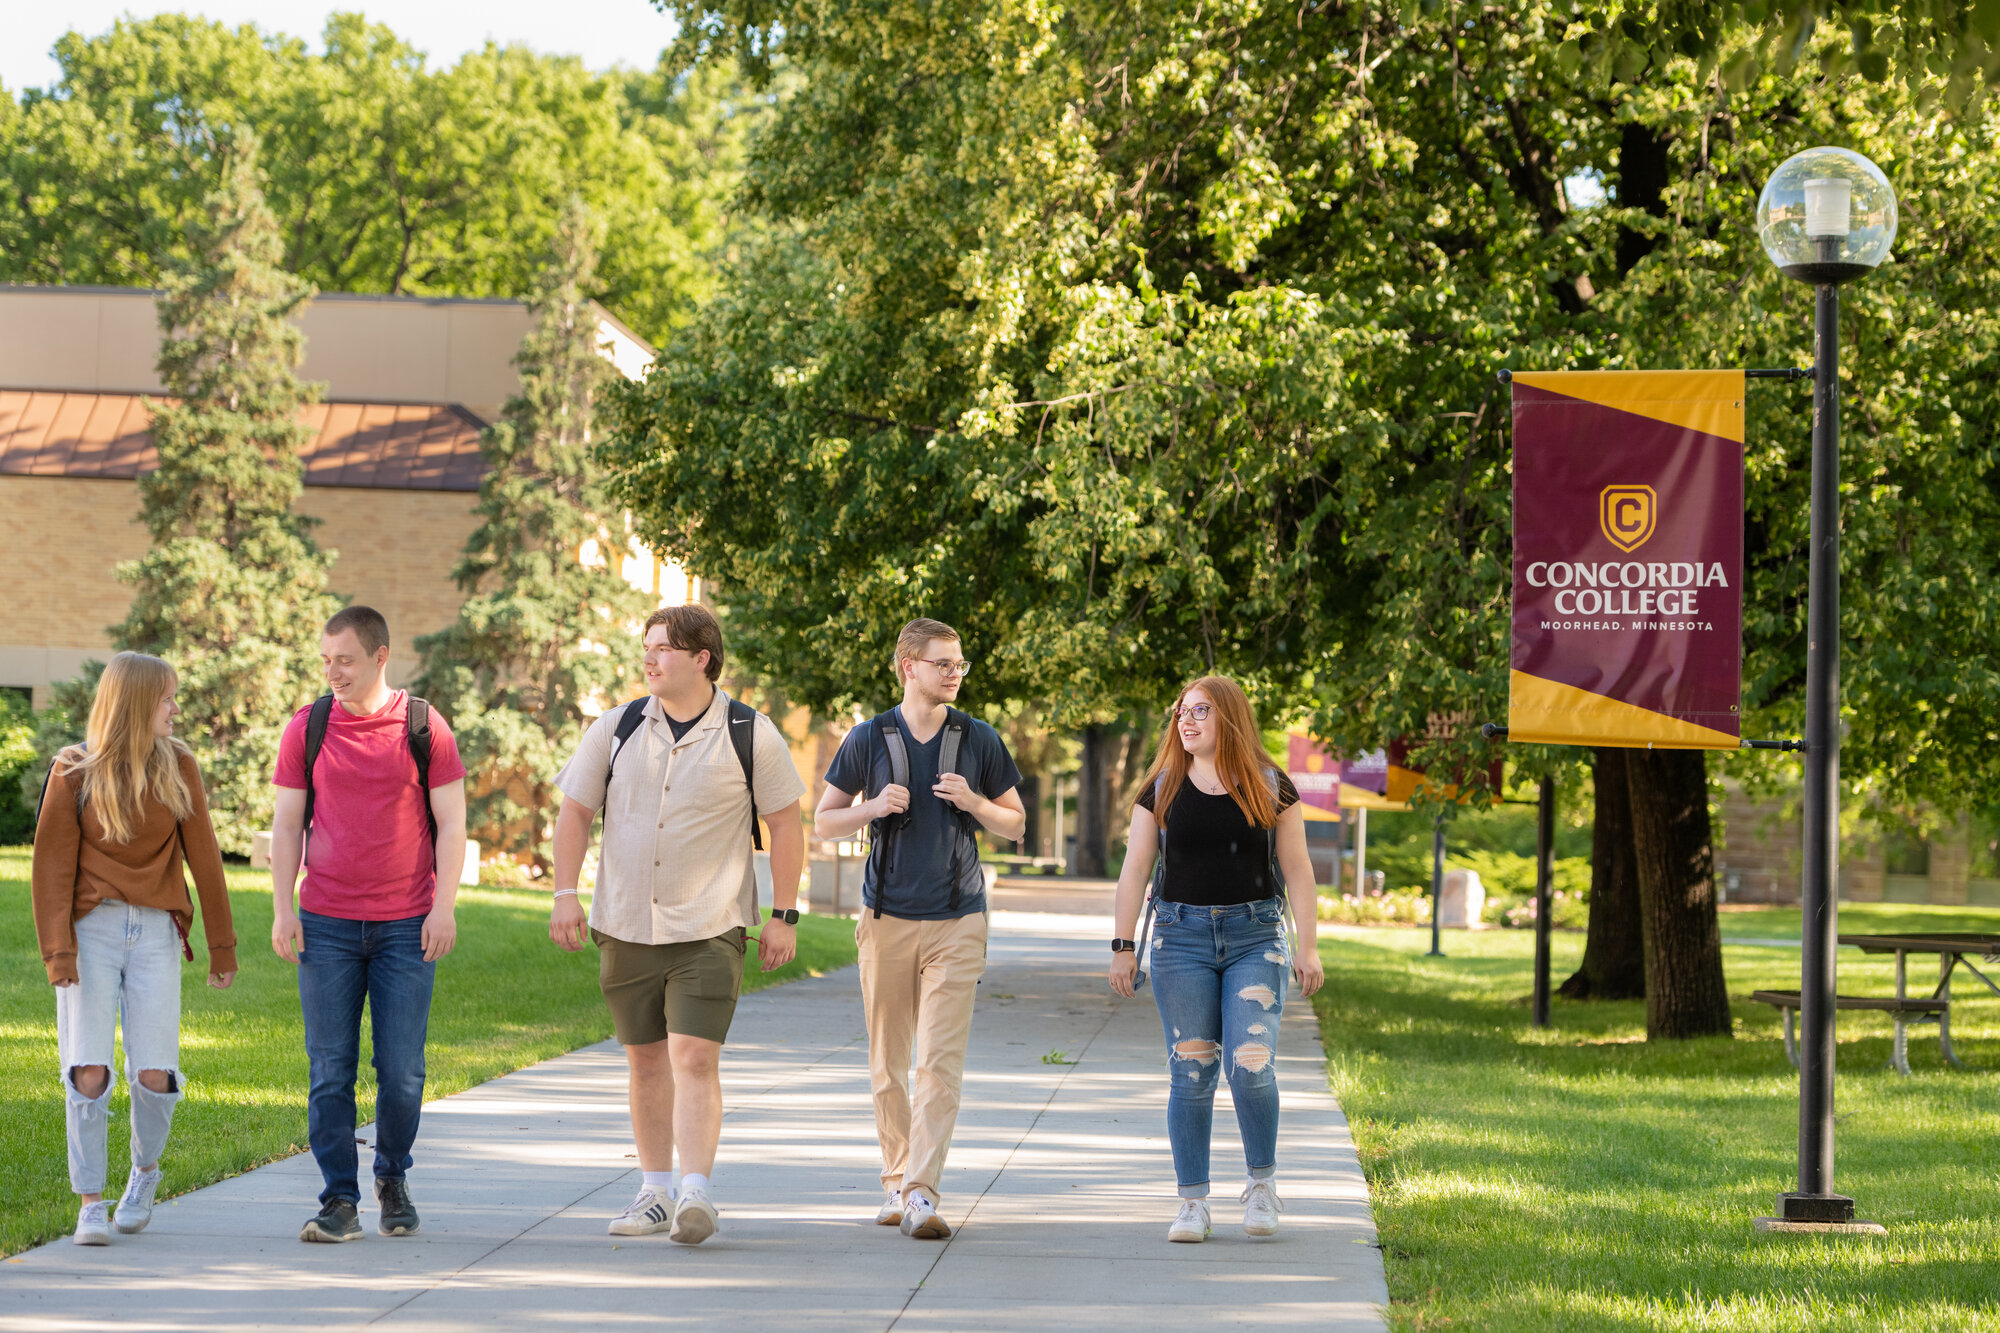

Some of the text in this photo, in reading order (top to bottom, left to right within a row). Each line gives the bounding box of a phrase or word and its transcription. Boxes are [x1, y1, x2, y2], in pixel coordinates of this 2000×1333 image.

[1615, 498, 1642, 533] C
[1525, 561, 1729, 588] CONCORDIA
[1554, 589, 1699, 615] COLLEGE
[1632, 621, 1713, 632] MINNESOTA
